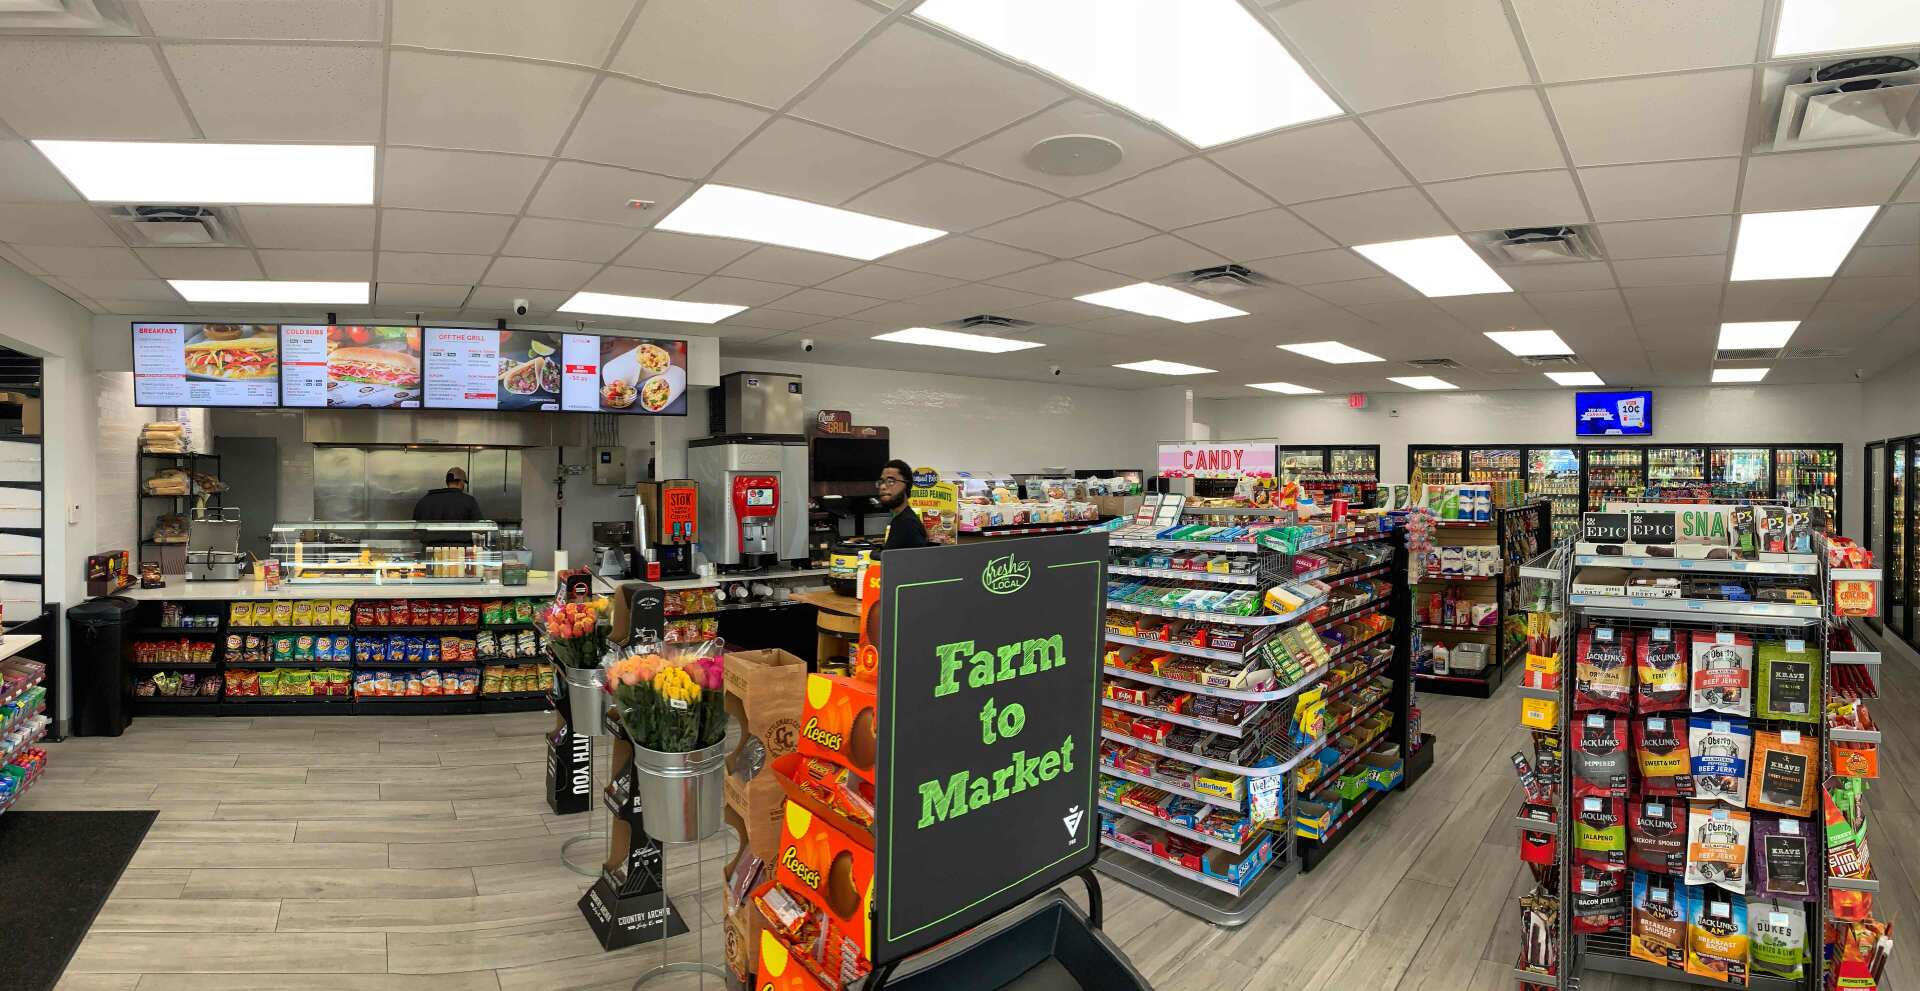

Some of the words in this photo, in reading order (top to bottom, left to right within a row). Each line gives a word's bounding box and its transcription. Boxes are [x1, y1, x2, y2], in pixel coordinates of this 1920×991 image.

[138, 327, 178, 335] BREAKFAST
[452, 334, 465, 342] THE
[1622, 405, 1640, 413] 10¢
[827, 421, 850, 434] GRILL
[1183, 449, 1244, 470] CANDY
[929, 489, 951, 502] PEANUTS
[1737, 510, 1753, 524] P3
[1793, 511, 1809, 525] P3
[1768, 517, 1785, 530] P3
[1586, 525, 1626, 537] EPIC
[1633, 523, 1673, 536] EPIC
[993, 579, 1020, 590] LOCAL
[1840, 591, 1869, 600] CRACKER
[1210, 638, 1237, 648] SNICKERS
[1585, 653, 1604, 661] JACK
[1604, 653, 1627, 663] LINK'S
[935, 634, 1066, 697] Farm
[1589, 671, 1620, 679] ORNAL
[1775, 671, 1805, 679] KRAVE
[980, 697, 1025, 744] to
[803, 717, 843, 751] Reese's
[1580, 739, 1598, 747] JACK
[1599, 739, 1620, 747] LINK'S
[1641, 739, 1659, 747] JACK
[1584, 760, 1616, 768] PEPPERED
[1770, 761, 1800, 772] KRAVE
[1716, 766, 1737, 774] JERKY
[573, 765, 590, 795] YOU
[918, 735, 1074, 829] Market
[1580, 812, 1597, 820] JACK
[1597, 813, 1618, 821] LINK'S
[1636, 817, 1654, 827] JACK
[1655, 818, 1678, 830] LINK'S
[1707, 823, 1732, 832] Oberto
[1634, 836, 1656, 845] HICKORY
[782, 845, 822, 890] Reese's
[1578, 898, 1599, 906] BACON
[1642, 900, 1659, 910] JACK
[1659, 904, 1679, 918] LINK'S
[618, 912, 646, 926] COUNTRY
[647, 907, 672, 919] ARCHR
[1653, 912, 1666, 920] AM
[1640, 918, 1676, 934] BREAKFAST
[1698, 916, 1716, 927] JACK
[1716, 919, 1738, 932] LINK'S
[1645, 925, 1672, 938] SAUSAGE
[1711, 927, 1725, 936] AM
[1698, 935, 1737, 948] BREAKFAST
[1706, 943, 1729, 953] BACON
